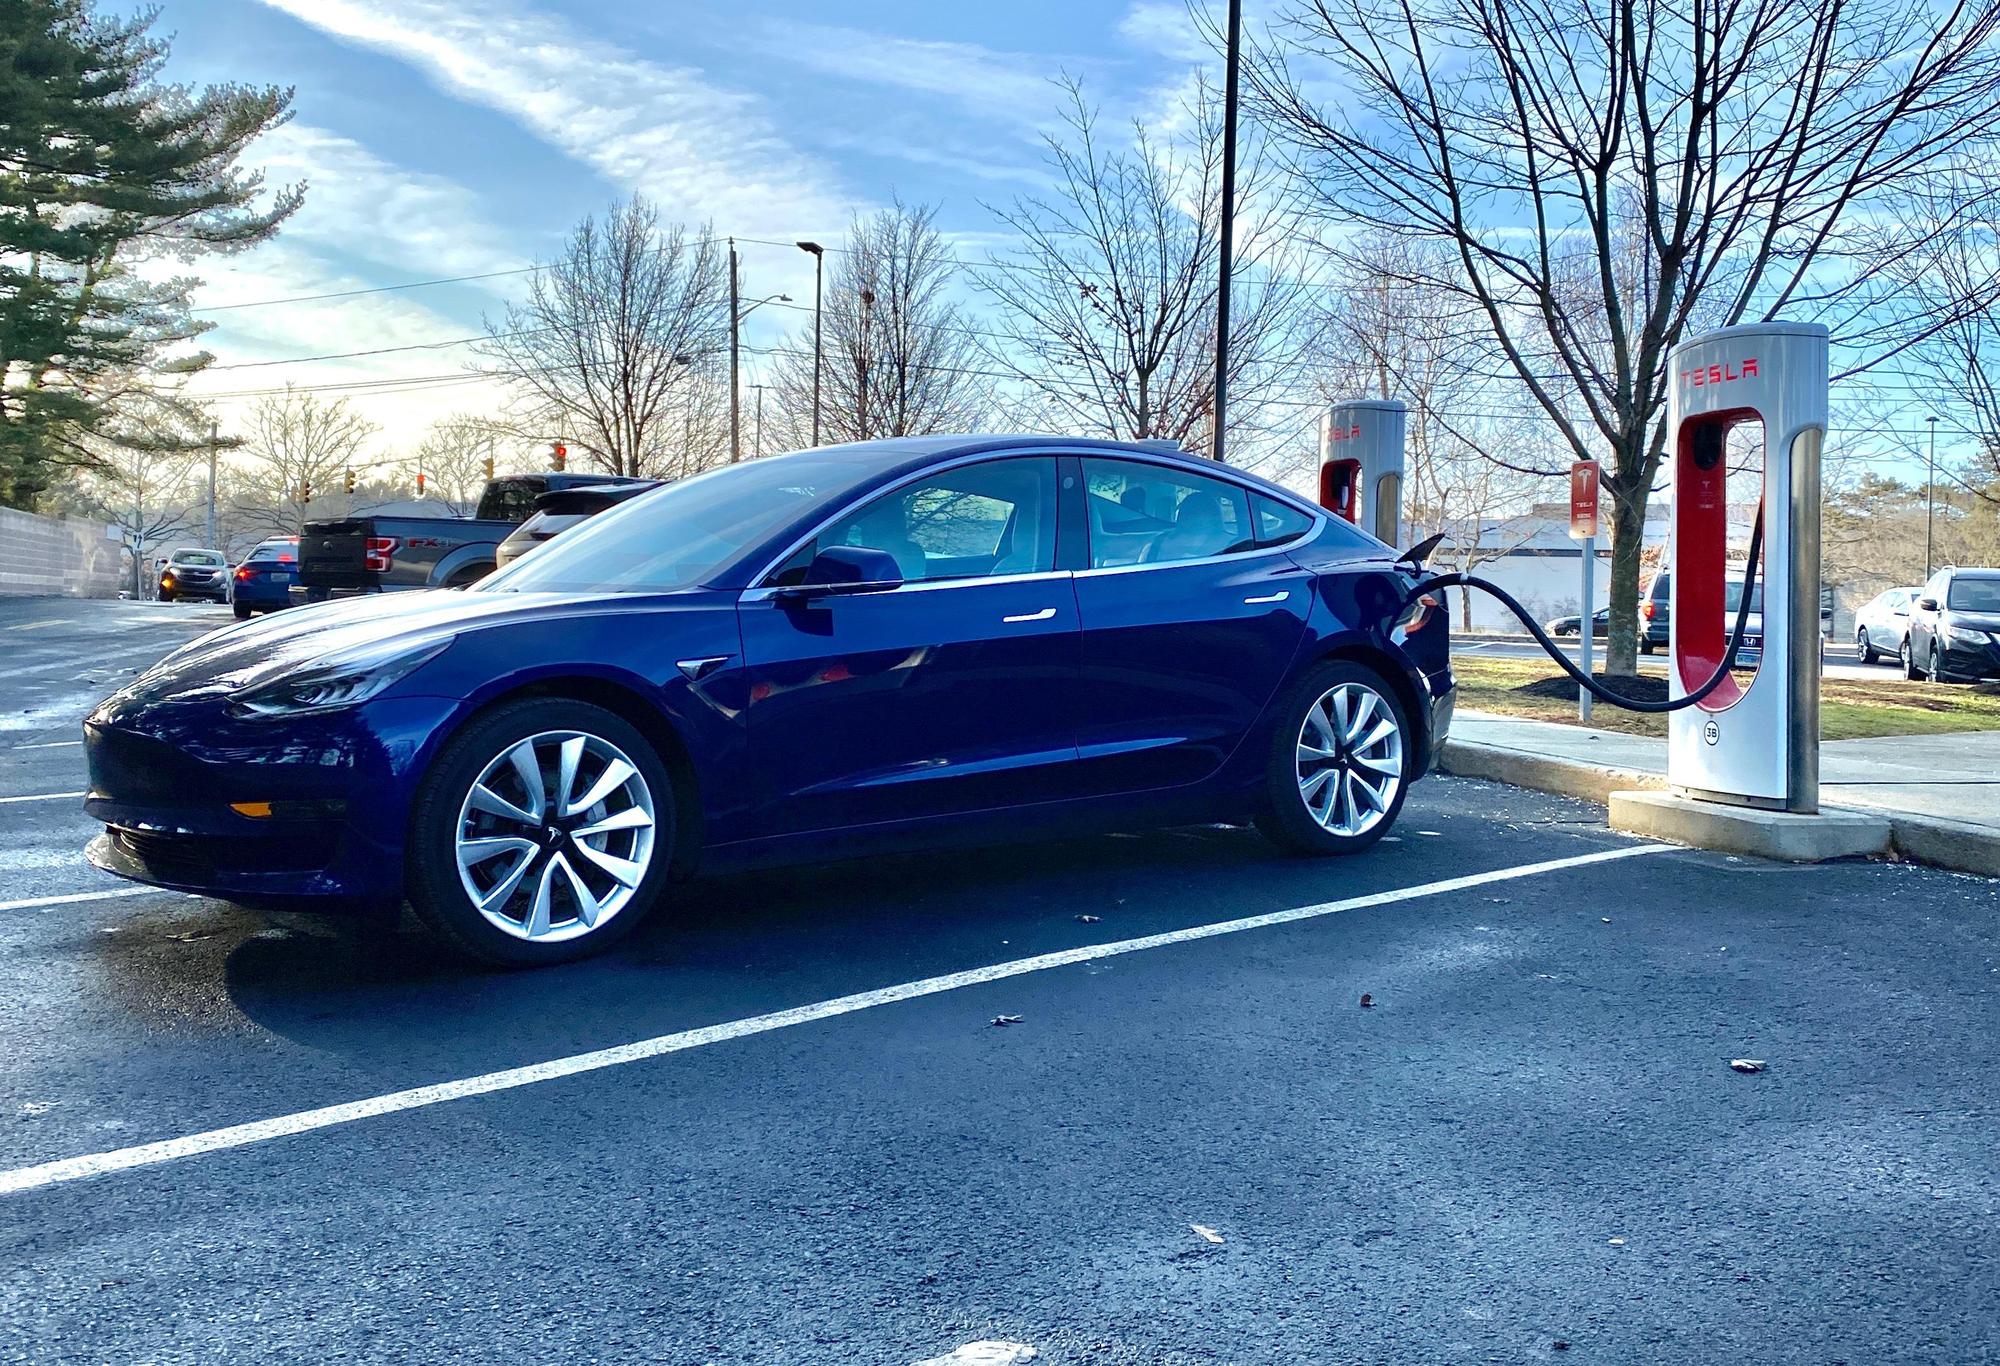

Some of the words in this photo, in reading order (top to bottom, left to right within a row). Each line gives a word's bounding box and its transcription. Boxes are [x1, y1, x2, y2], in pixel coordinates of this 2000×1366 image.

[1681, 359, 1758, 388] TESLA
[1327, 424, 1360, 441] SLA
[1707, 727, 1717, 738] 3B
